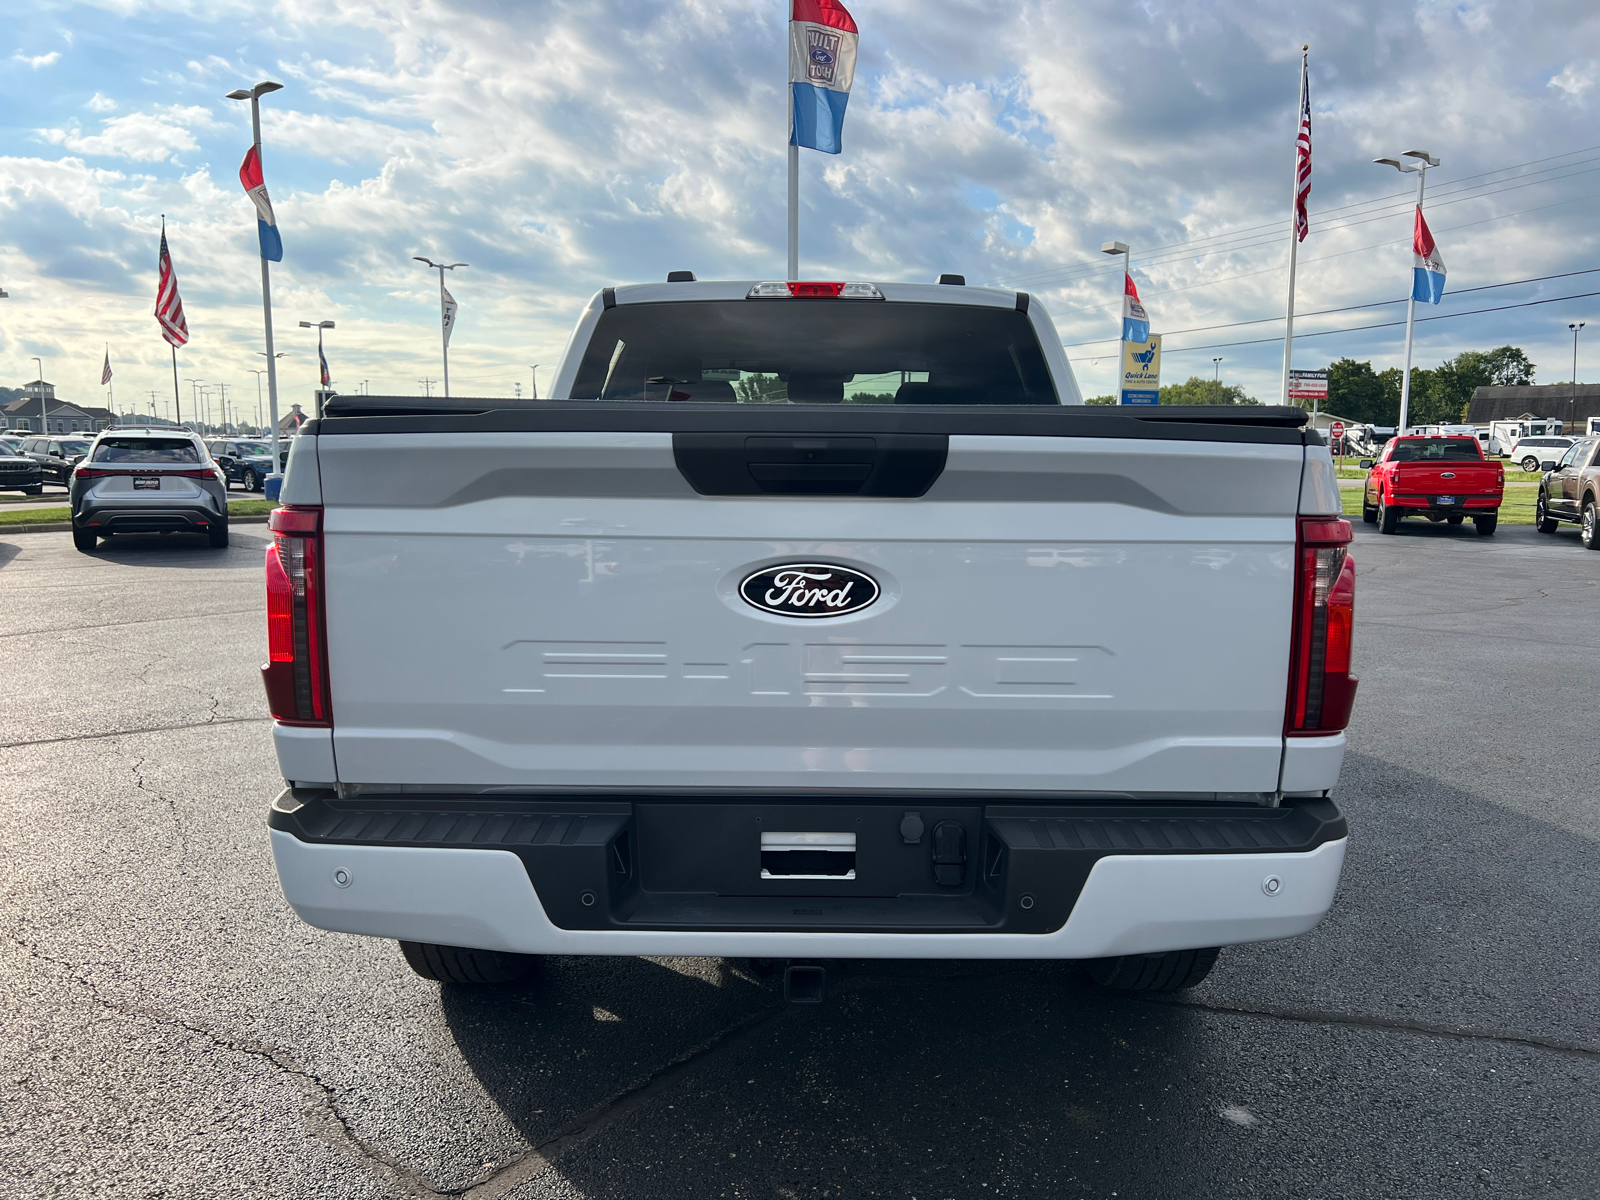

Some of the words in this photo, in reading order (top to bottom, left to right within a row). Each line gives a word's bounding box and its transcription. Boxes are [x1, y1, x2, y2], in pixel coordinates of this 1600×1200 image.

[1125, 371, 1144, 379] Quick
[765, 571, 854, 607] Ford
[502, 640, 1114, 698] F-150
